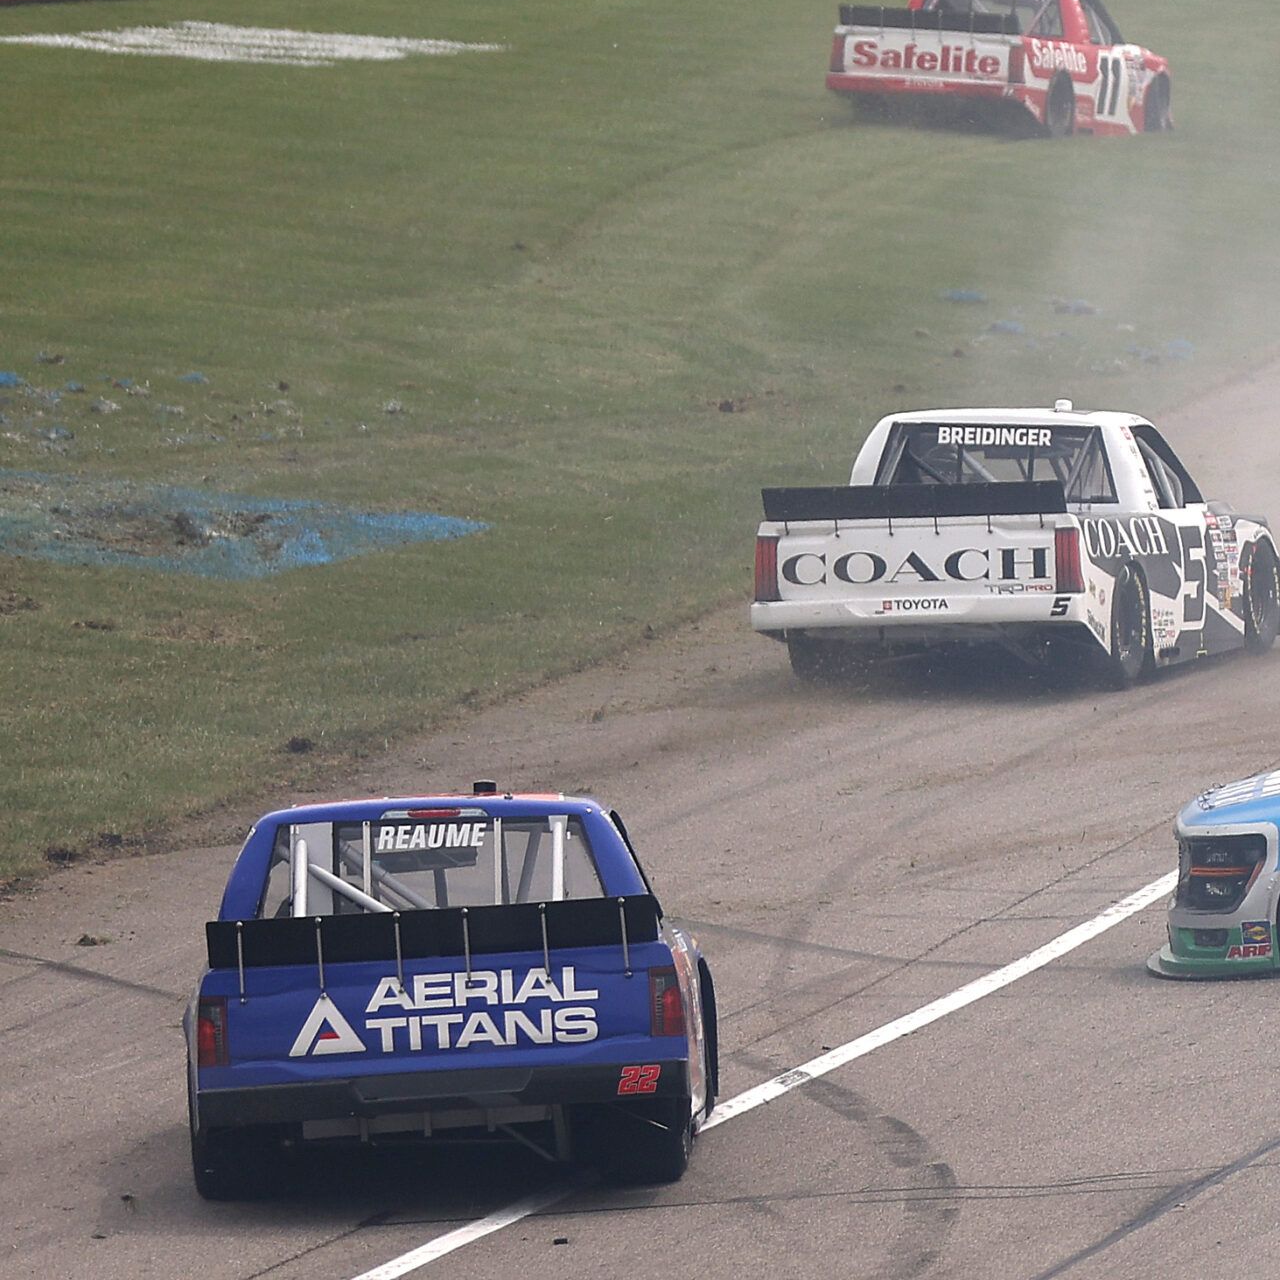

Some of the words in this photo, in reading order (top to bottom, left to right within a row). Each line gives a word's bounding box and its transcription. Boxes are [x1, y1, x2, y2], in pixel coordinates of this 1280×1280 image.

[851, 39, 1001, 75] Safelite
[1031, 38, 1088, 74] Safelite
[1096, 54, 1122, 117] 11
[937, 426, 1052, 448] BREIDINGER
[1083, 516, 1170, 558] COACH
[781, 546, 1052, 587] COACH
[1177, 524, 1207, 625] 5
[893, 598, 949, 611] TOYOTA
[1050, 596, 1072, 618] 5
[377, 821, 488, 851] REAUME
[1227, 944, 1273, 959] ARP
[366, 965, 599, 1013] AERIAL
[366, 1007, 599, 1053] TITANS
[616, 1063, 662, 1096] 22
